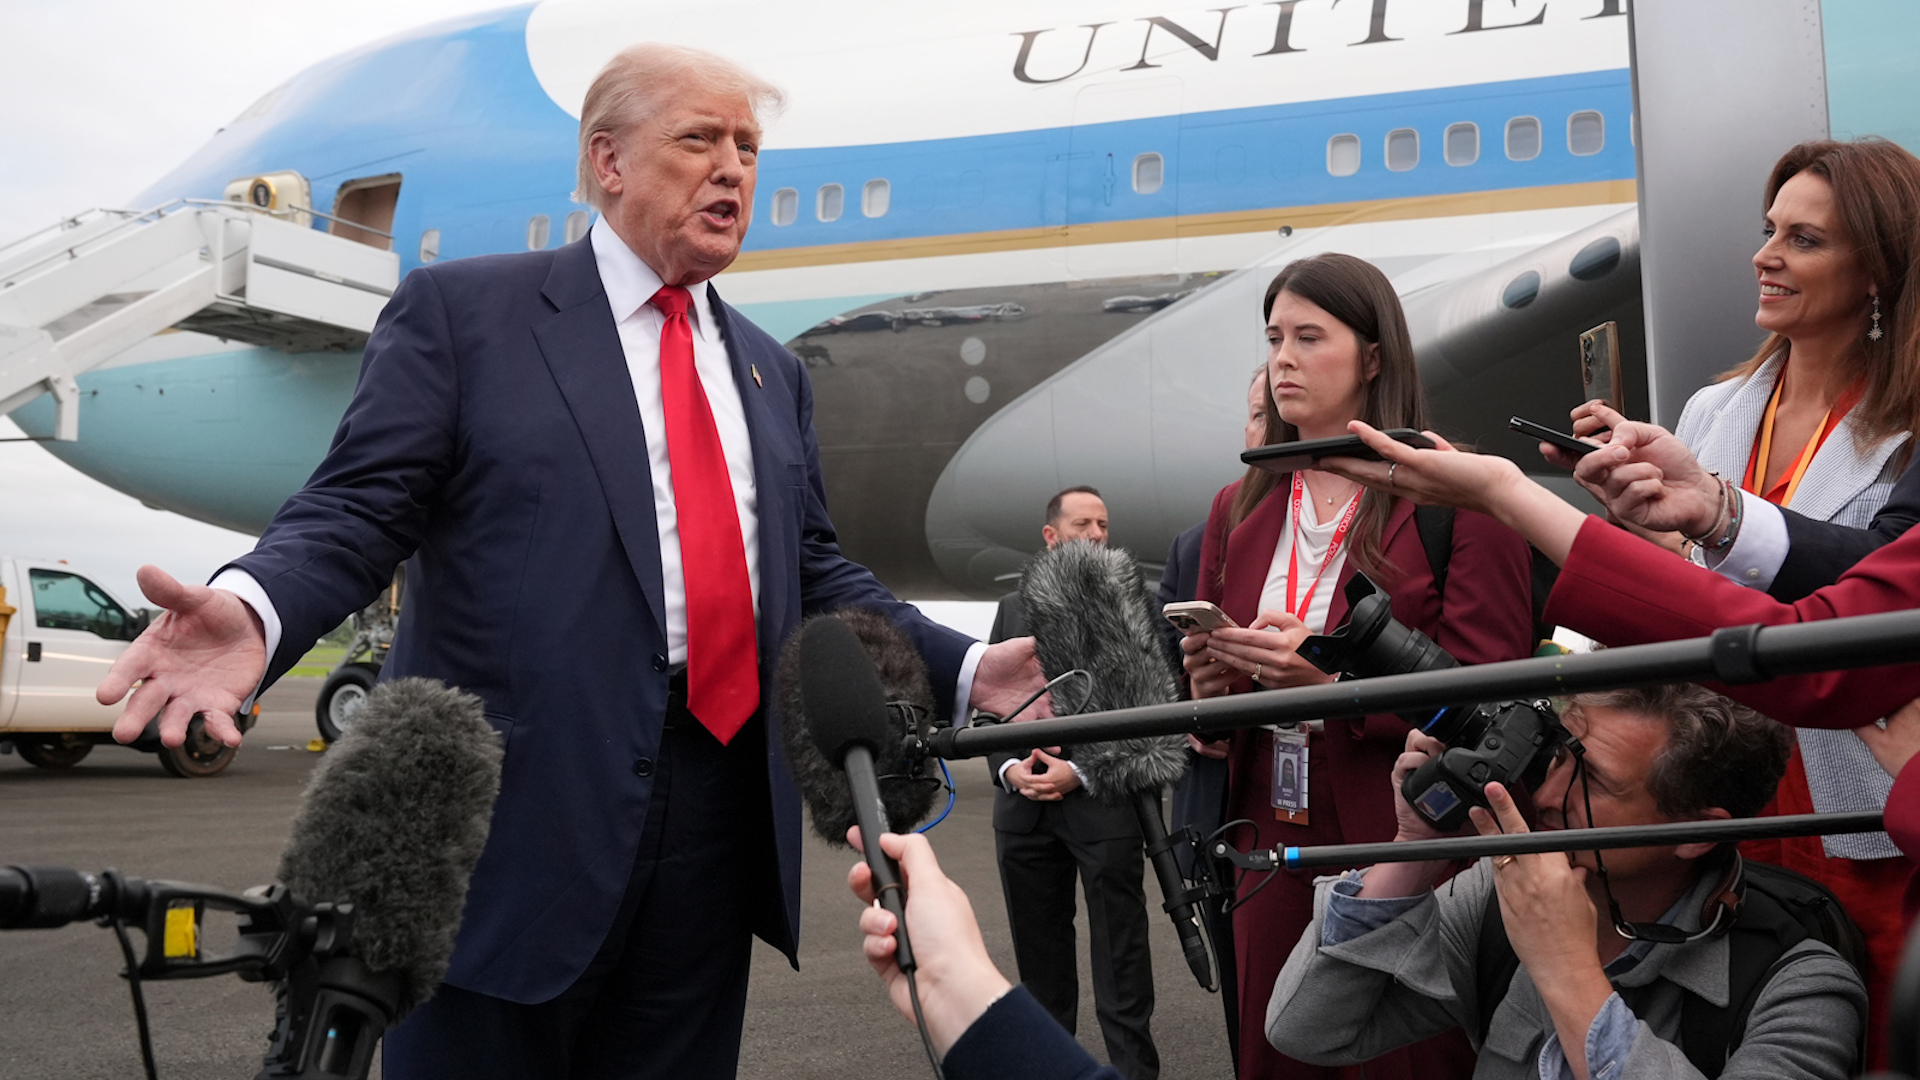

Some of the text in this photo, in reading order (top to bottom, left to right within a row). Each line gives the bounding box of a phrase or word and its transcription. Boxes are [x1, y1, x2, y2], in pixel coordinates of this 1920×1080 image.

[1009, 0, 1627, 84] UNITE
[1338, 501, 1358, 533] POLITICO
[1283, 800, 1296, 808] PRESS
